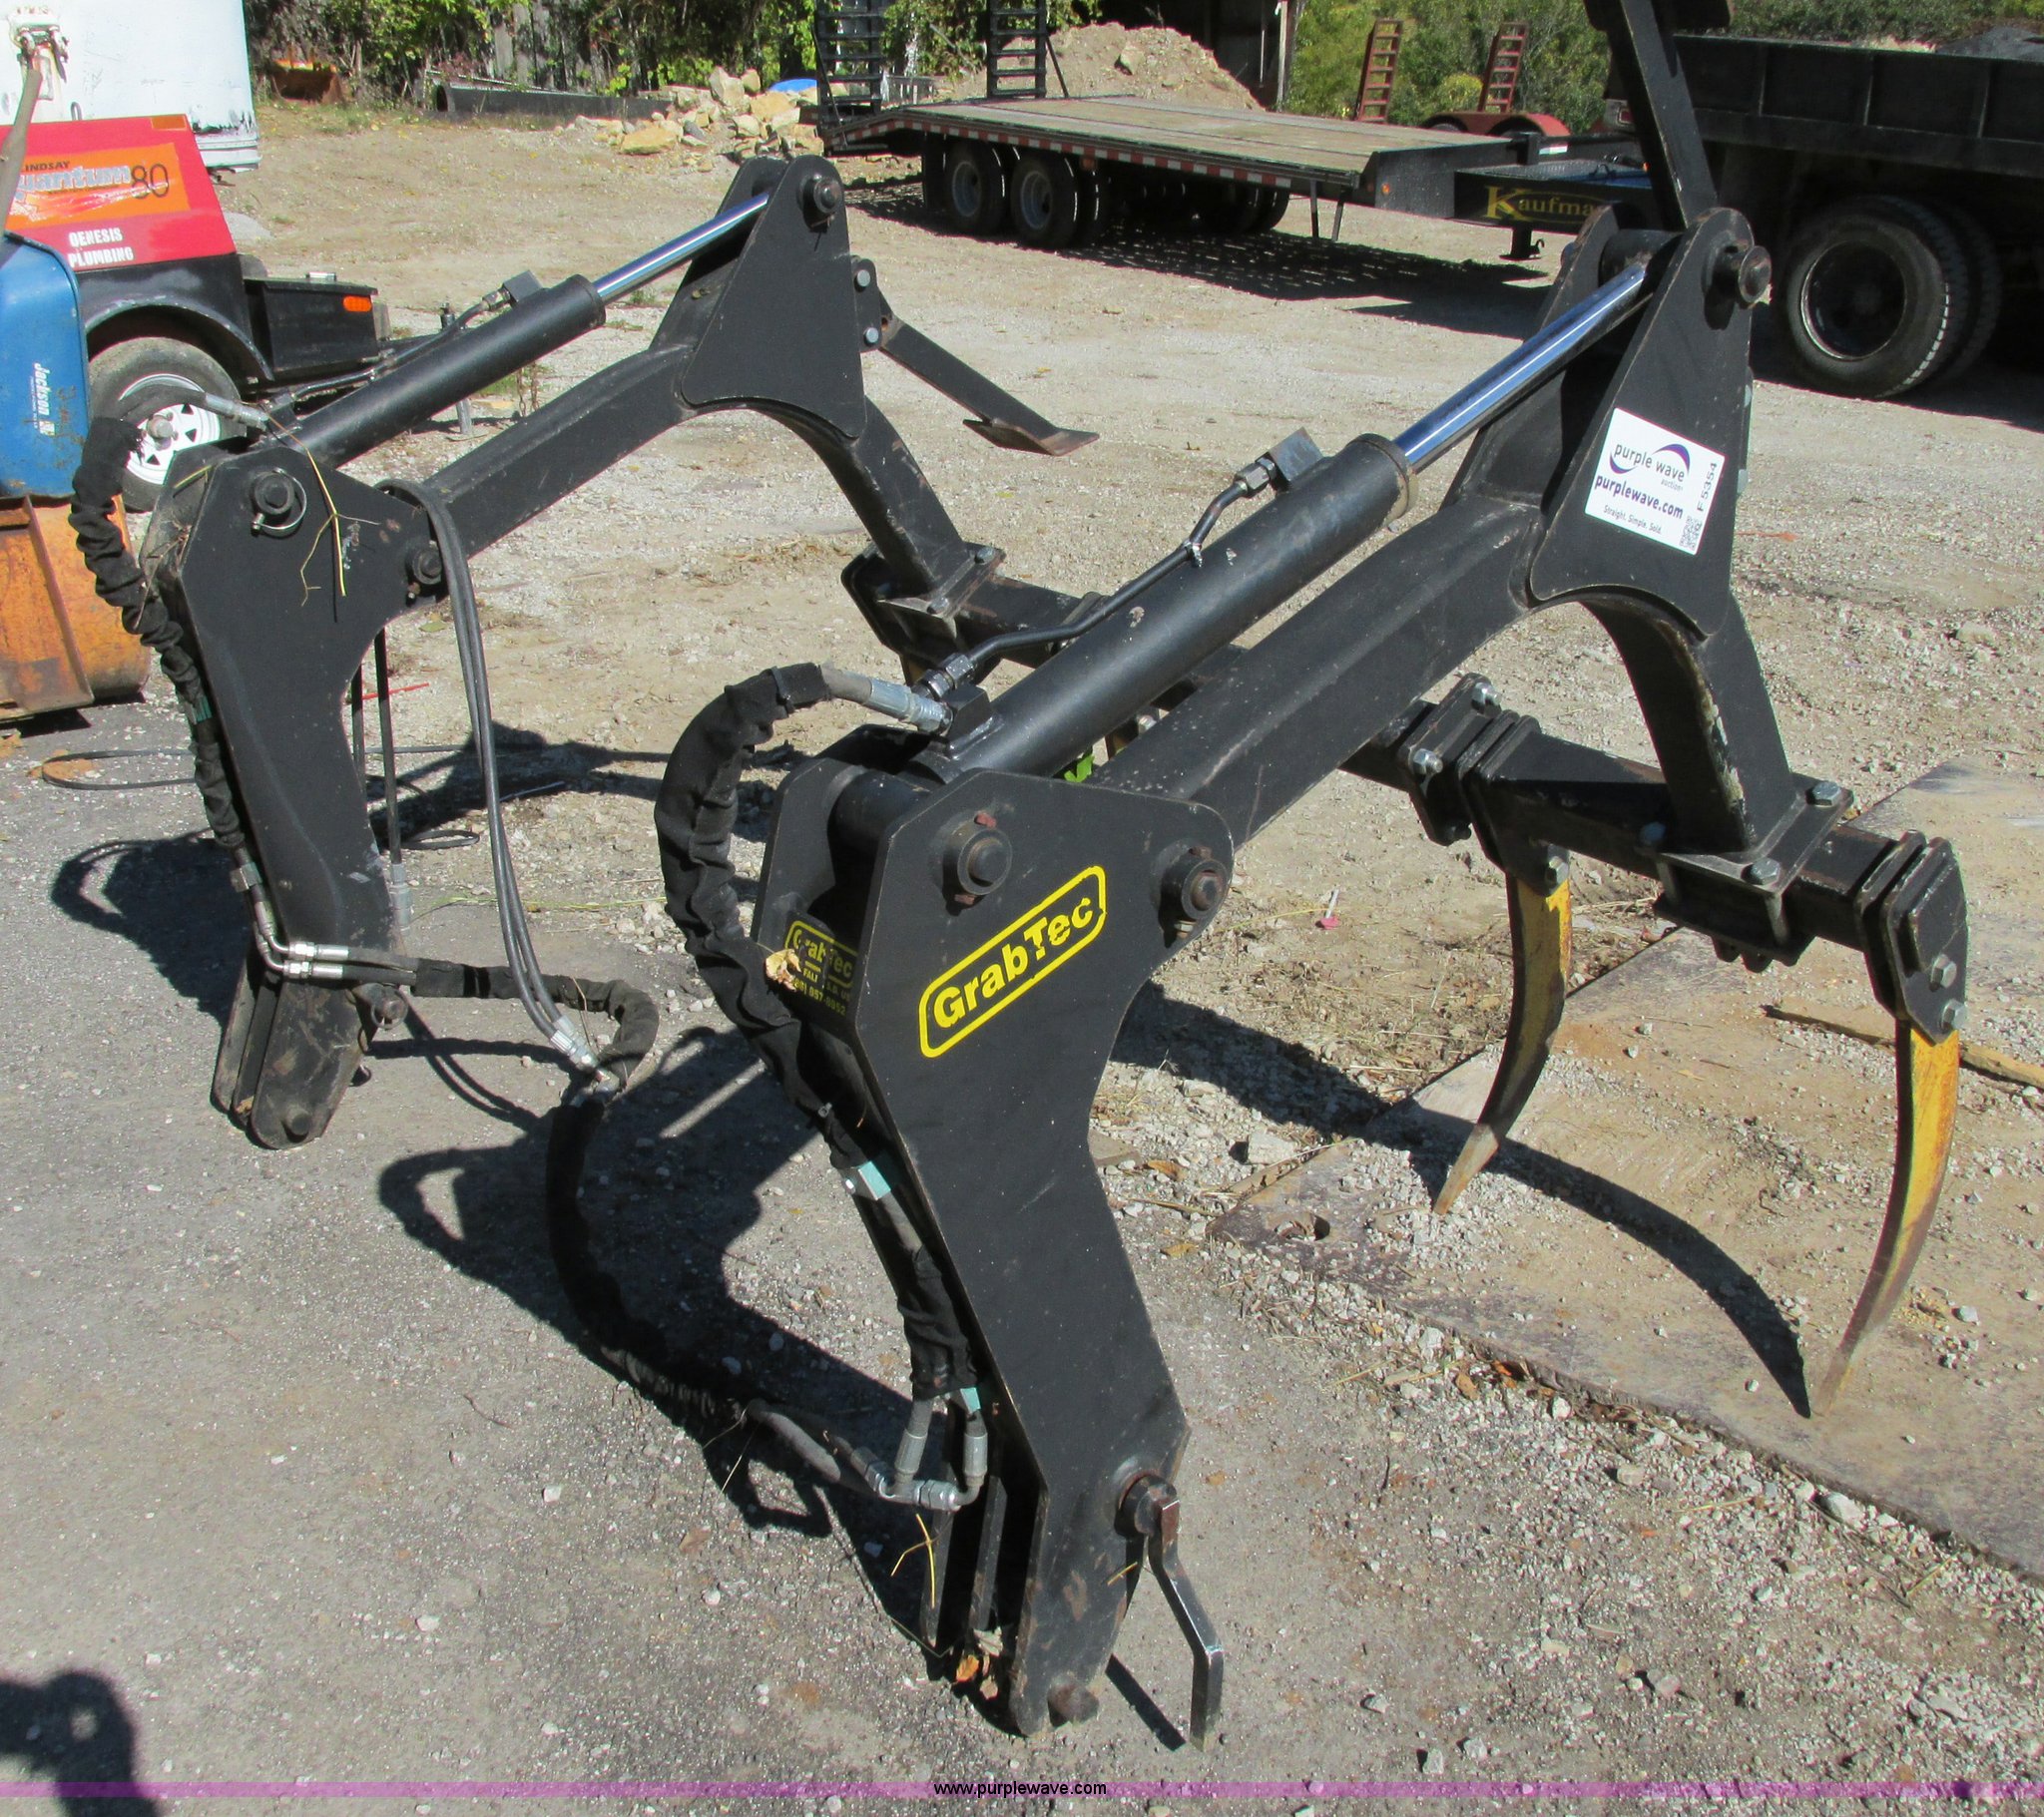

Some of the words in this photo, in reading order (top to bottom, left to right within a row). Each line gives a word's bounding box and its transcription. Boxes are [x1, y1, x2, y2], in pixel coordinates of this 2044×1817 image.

[17, 166, 131, 193] uantum
[131, 164, 169, 199] 80
[1483, 186, 1595, 223] Kaufma
[68, 246, 134, 268] PLUMBING
[34, 362, 50, 415] Jackson
[1614, 443, 1652, 468] purple
[1656, 460, 1685, 482] wave
[1701, 462, 1718, 499] 5354
[1594, 474, 1684, 519] purplewave.com
[1603, 505, 1626, 521] Straight.
[1629, 514, 1648, 529] Simple.
[933, 897, 1094, 1028] GrabTec
